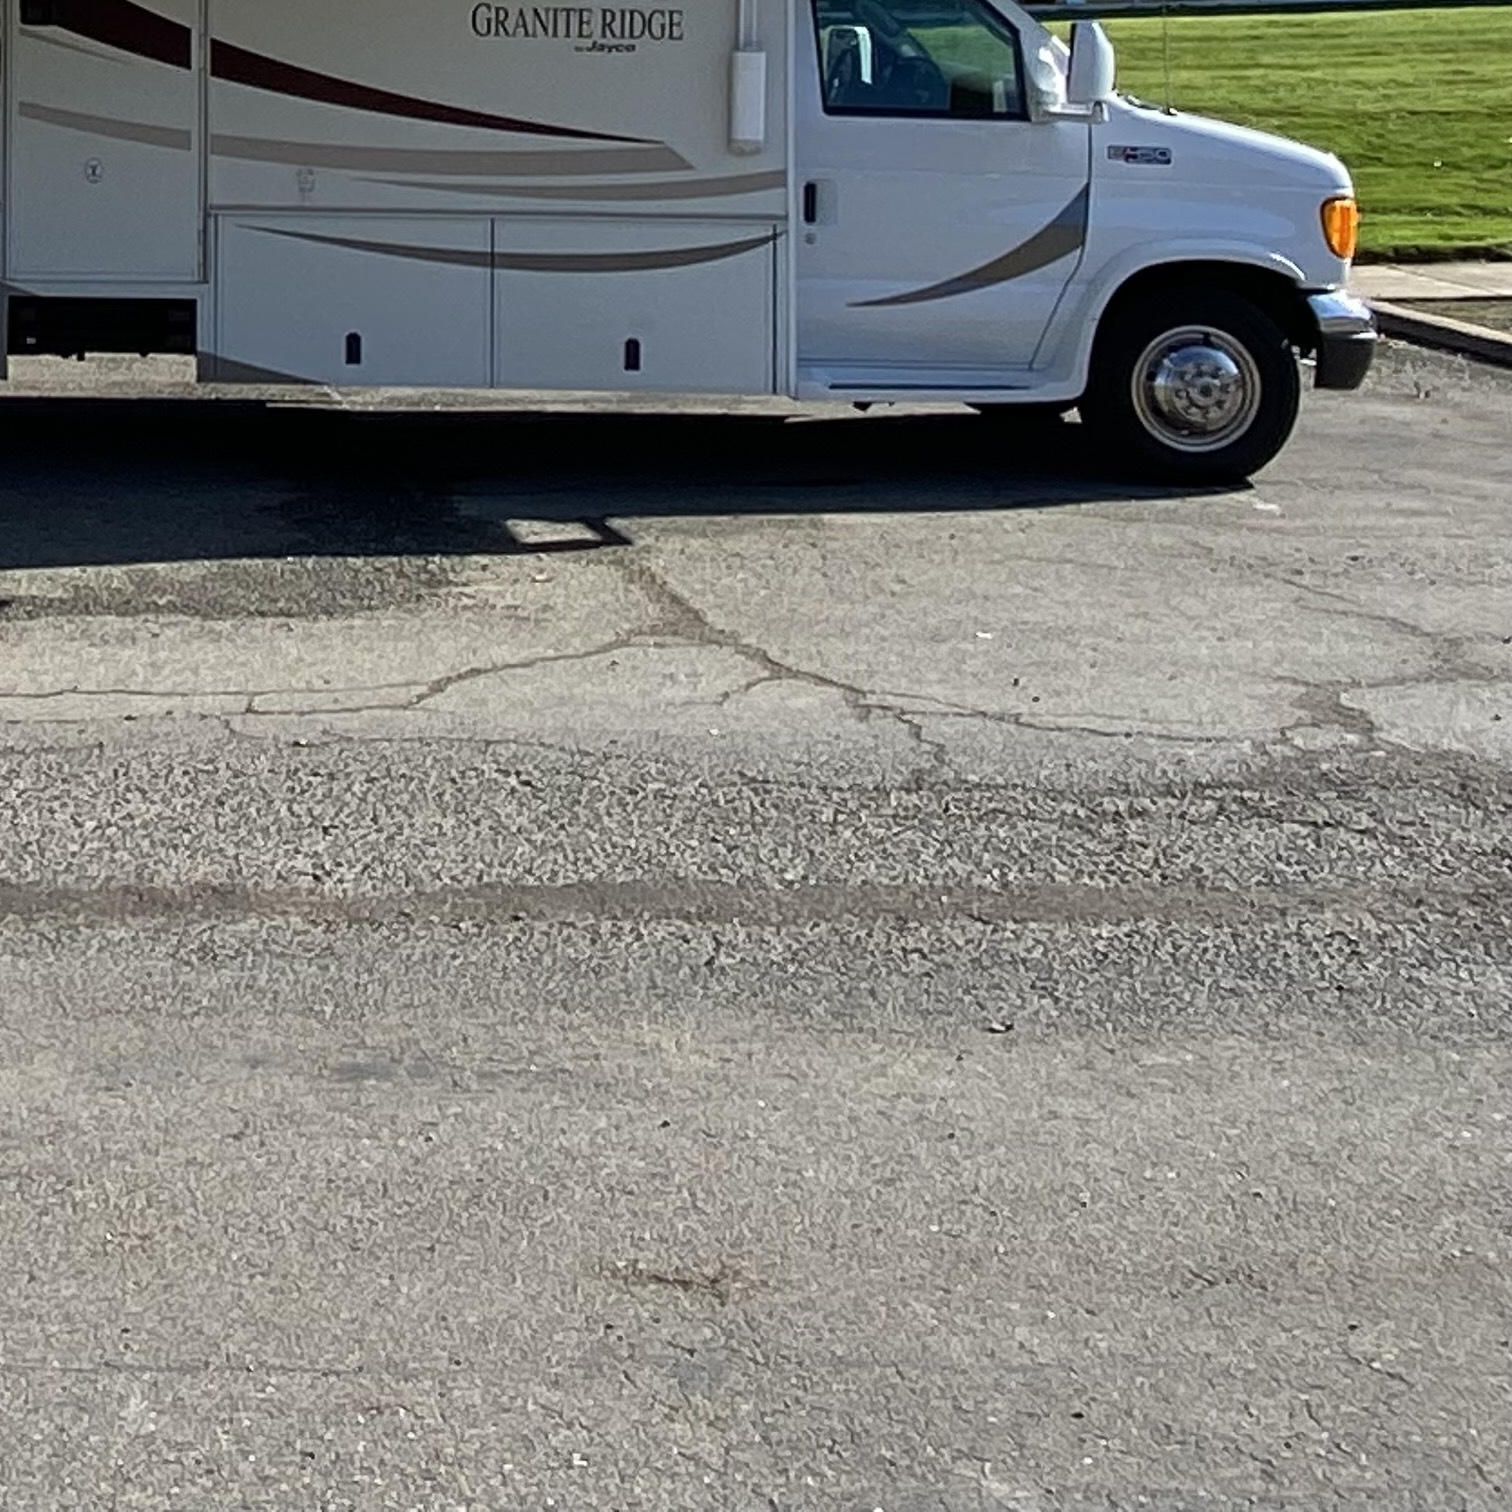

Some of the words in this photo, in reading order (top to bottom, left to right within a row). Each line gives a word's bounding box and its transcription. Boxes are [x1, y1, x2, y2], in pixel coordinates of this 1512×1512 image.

[471, 2, 593, 38] GRANITE
[600, 8, 684, 41] RIDGE
[586, 41, 636, 53] Jayco
